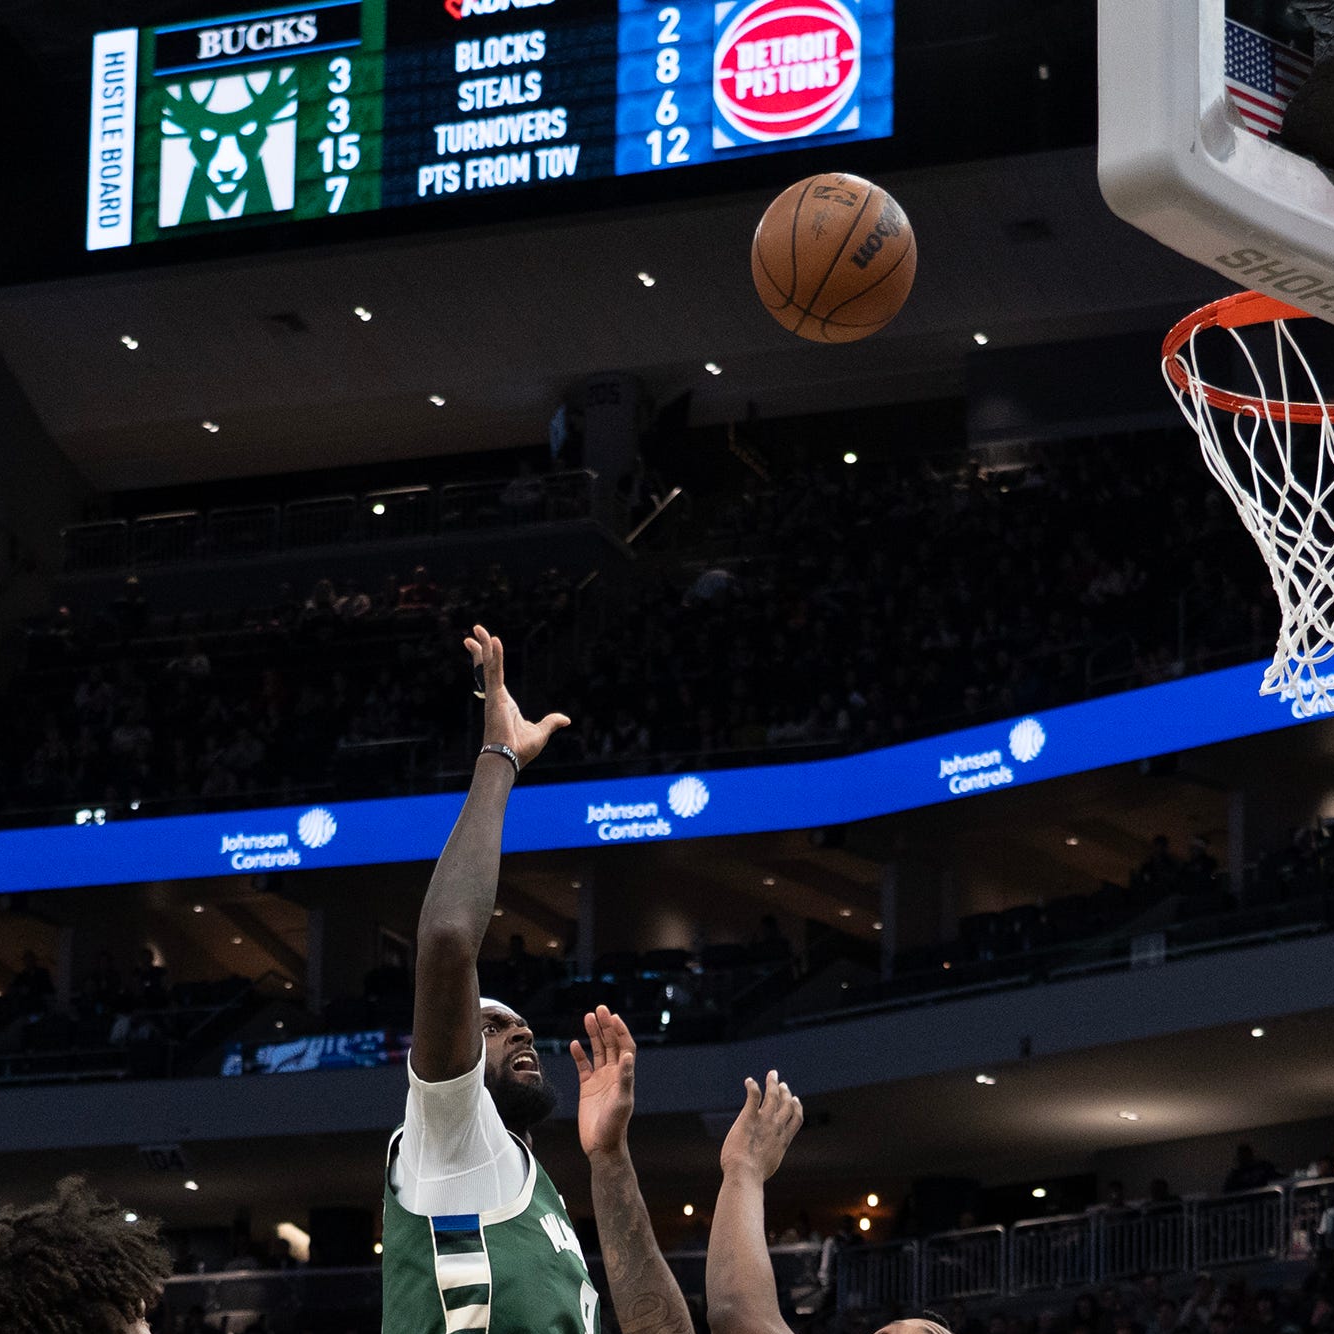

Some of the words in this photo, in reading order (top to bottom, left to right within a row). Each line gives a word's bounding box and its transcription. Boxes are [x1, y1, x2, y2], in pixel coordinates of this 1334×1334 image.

[197, 14, 318, 59] BUCKS
[658, 8, 680, 43] 2
[456, 31, 545, 72] BLOCKS
[656, 48, 680, 83] 8
[736, 29, 839, 69] DETROIT
[329, 58, 350, 93] 3
[458, 72, 541, 111] STEALS
[735, 59, 839, 101] PISTONS
[100, 51, 126, 139] HUSTLE
[656, 90, 678, 125] 6
[327, 98, 349, 132] 3
[434, 108, 566, 155] TURNOVERS
[319, 134, 359, 172] 15
[647, 127, 689, 165] 12
[98, 148, 123, 229] BOARD
[419, 163, 460, 196] PTS
[466, 153, 530, 190] FROM
[535, 146, 579, 179] TOV
[326, 177, 348, 213] 7
[939, 749, 1002, 778] Johnson
[949, 766, 1013, 794] Controls
[587, 803, 657, 823] Johnson
[598, 818, 671, 840] Controls
[221, 834, 288, 853] Johnson
[232, 849, 300, 869] Controls
